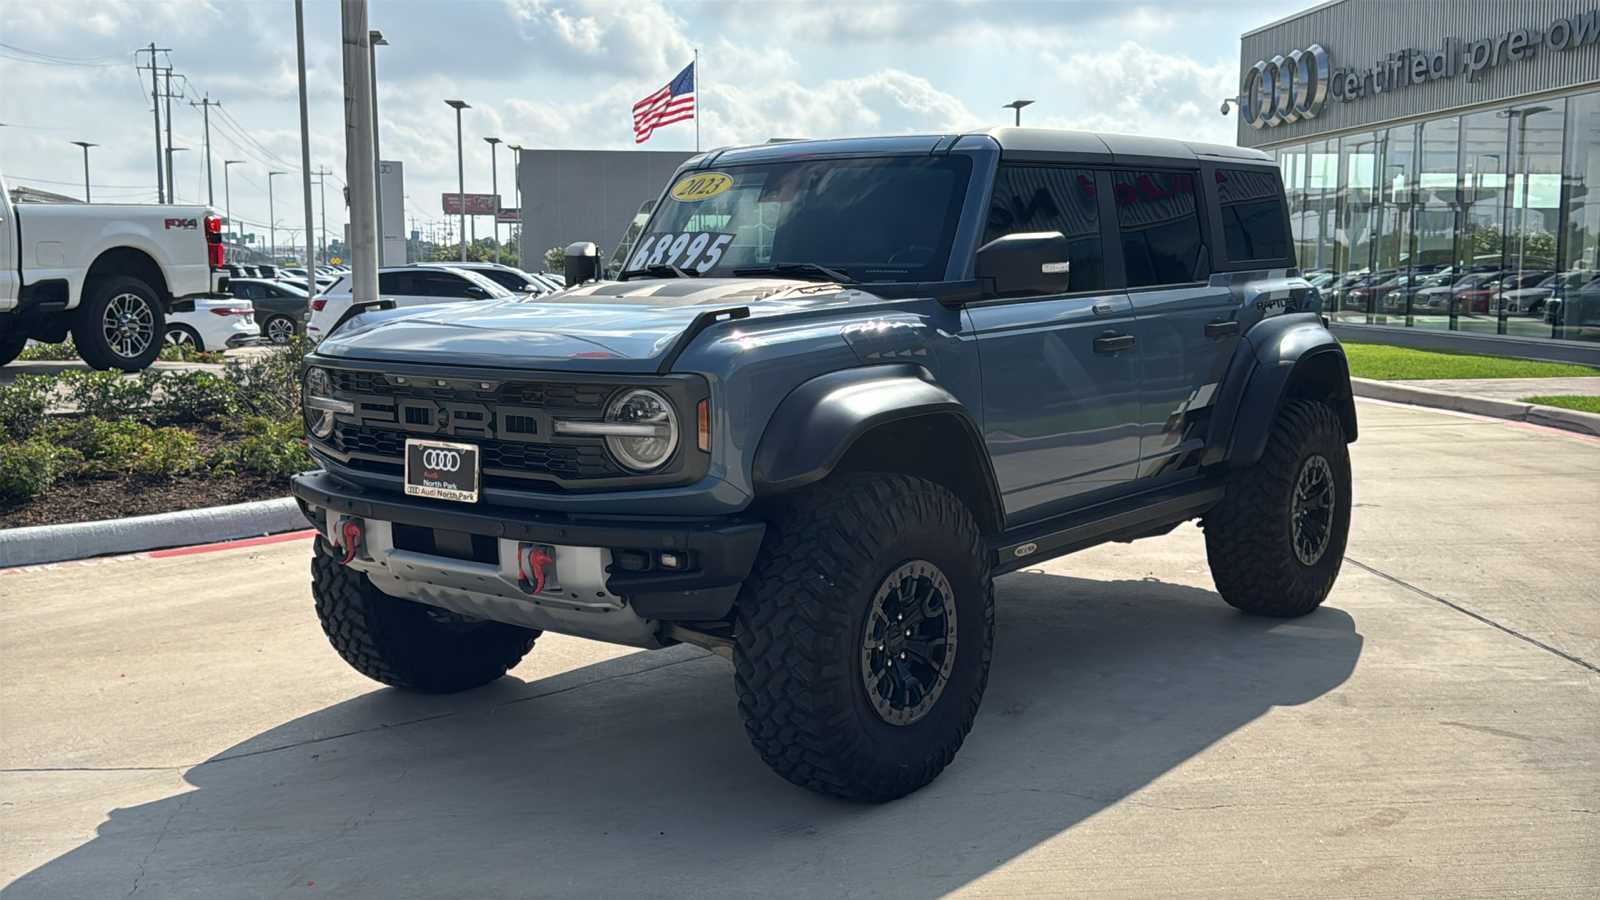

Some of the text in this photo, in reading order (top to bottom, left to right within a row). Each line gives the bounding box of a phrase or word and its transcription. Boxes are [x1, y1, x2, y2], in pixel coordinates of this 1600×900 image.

[1330, 37, 1457, 103] Certified
[677, 177, 726, 196] 2023
[164, 218, 198, 230] FX4
[630, 233, 733, 273] 68995
[1256, 297, 1295, 313] RAPTOR
[352, 397, 551, 442] FORD
[424, 471, 438, 479] Audi
[423, 480, 458, 490] North Park
[421, 488, 474, 501] Audi North Park
